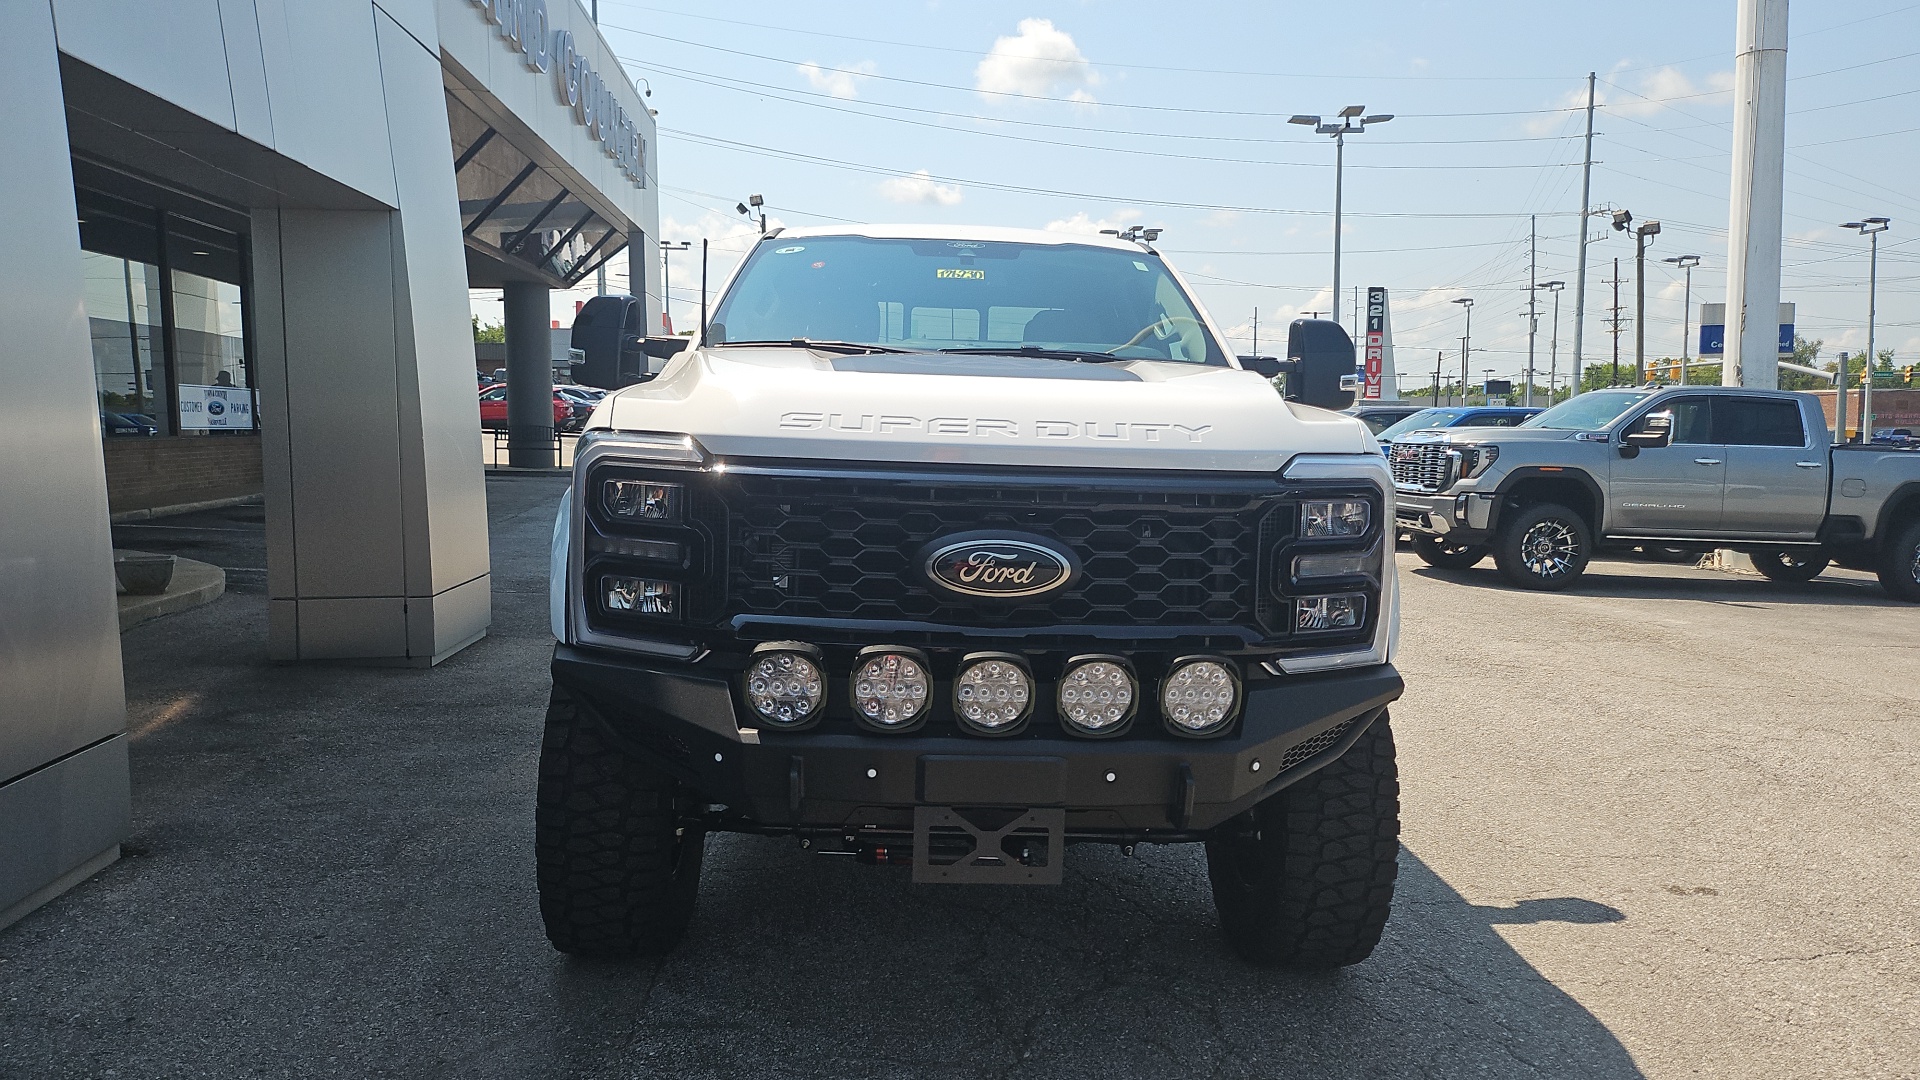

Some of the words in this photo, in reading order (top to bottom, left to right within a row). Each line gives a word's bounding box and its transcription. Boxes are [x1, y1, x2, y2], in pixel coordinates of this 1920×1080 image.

[1369, 291, 1383, 330] 321
[1366, 335, 1382, 397] DRIVE
[180, 401, 202, 412] CUSTOMER
[230, 403, 249, 414] PARKING
[778, 411, 1020, 438] SUPER
[1035, 420, 1214, 443] DUTY
[959, 551, 1038, 585] Ford
